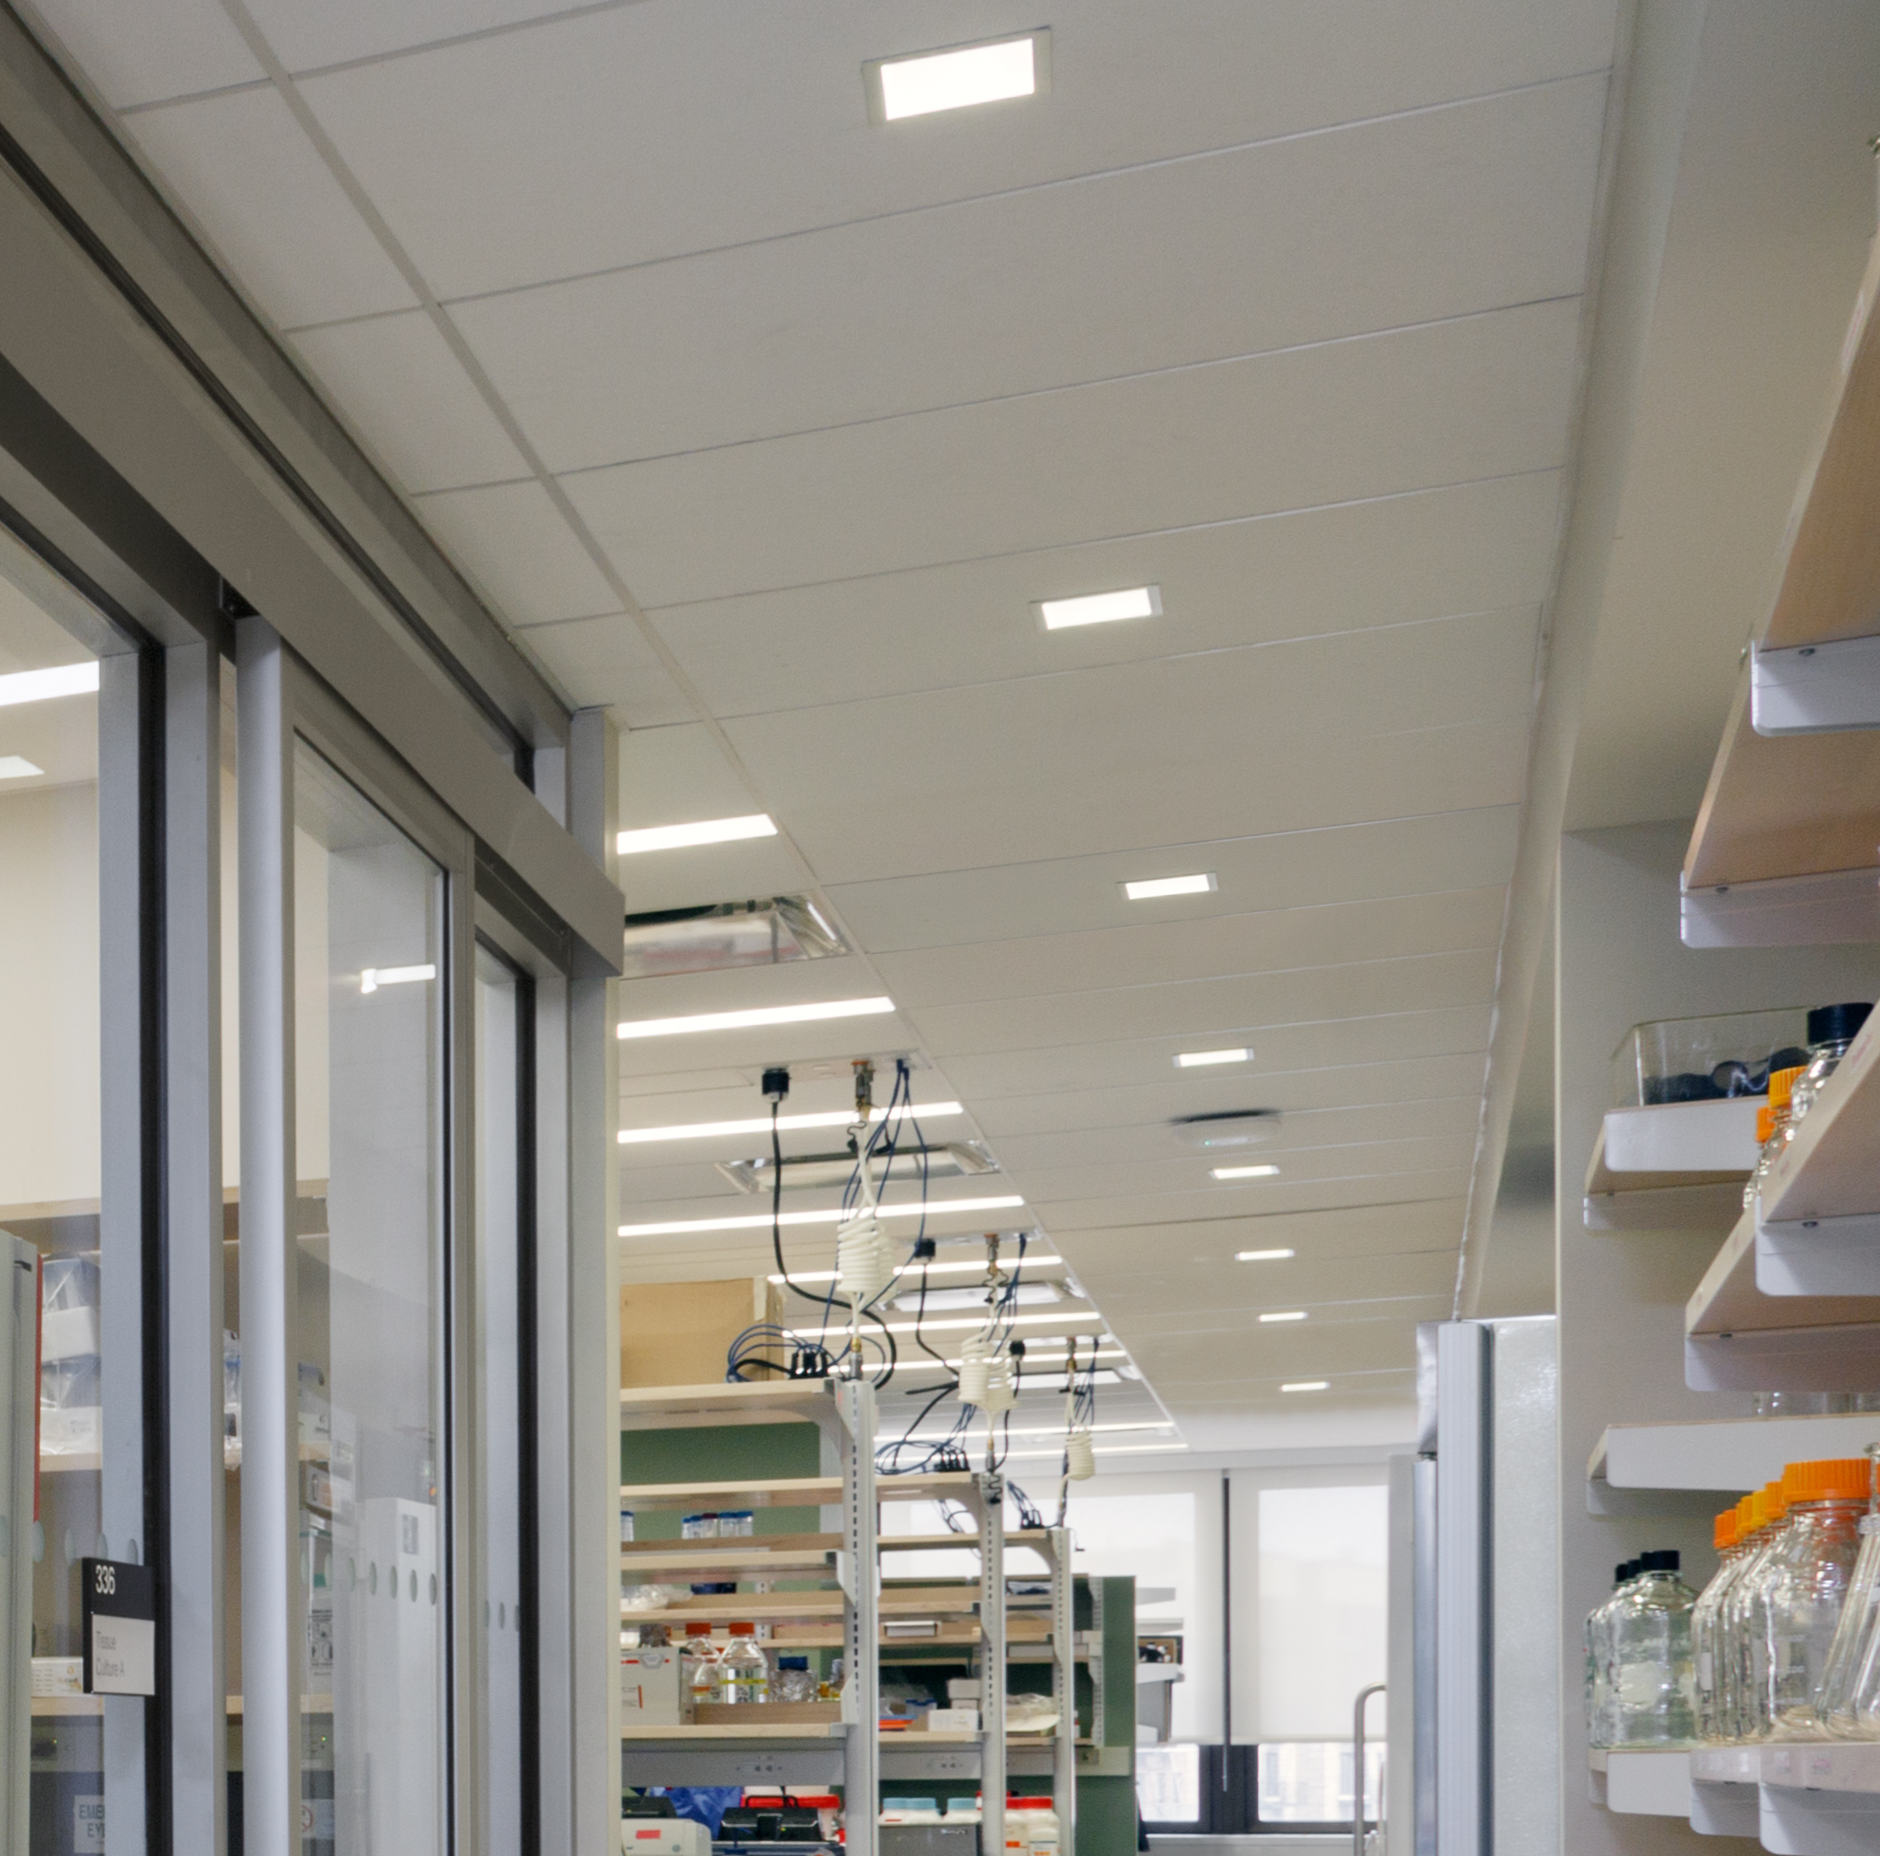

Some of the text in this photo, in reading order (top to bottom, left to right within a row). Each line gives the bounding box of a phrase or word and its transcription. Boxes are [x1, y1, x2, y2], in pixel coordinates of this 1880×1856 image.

[95, 1564, 116, 1595] 336
[96, 1631, 117, 1650] Tissue
[96, 1658, 125, 1677] Culture A
